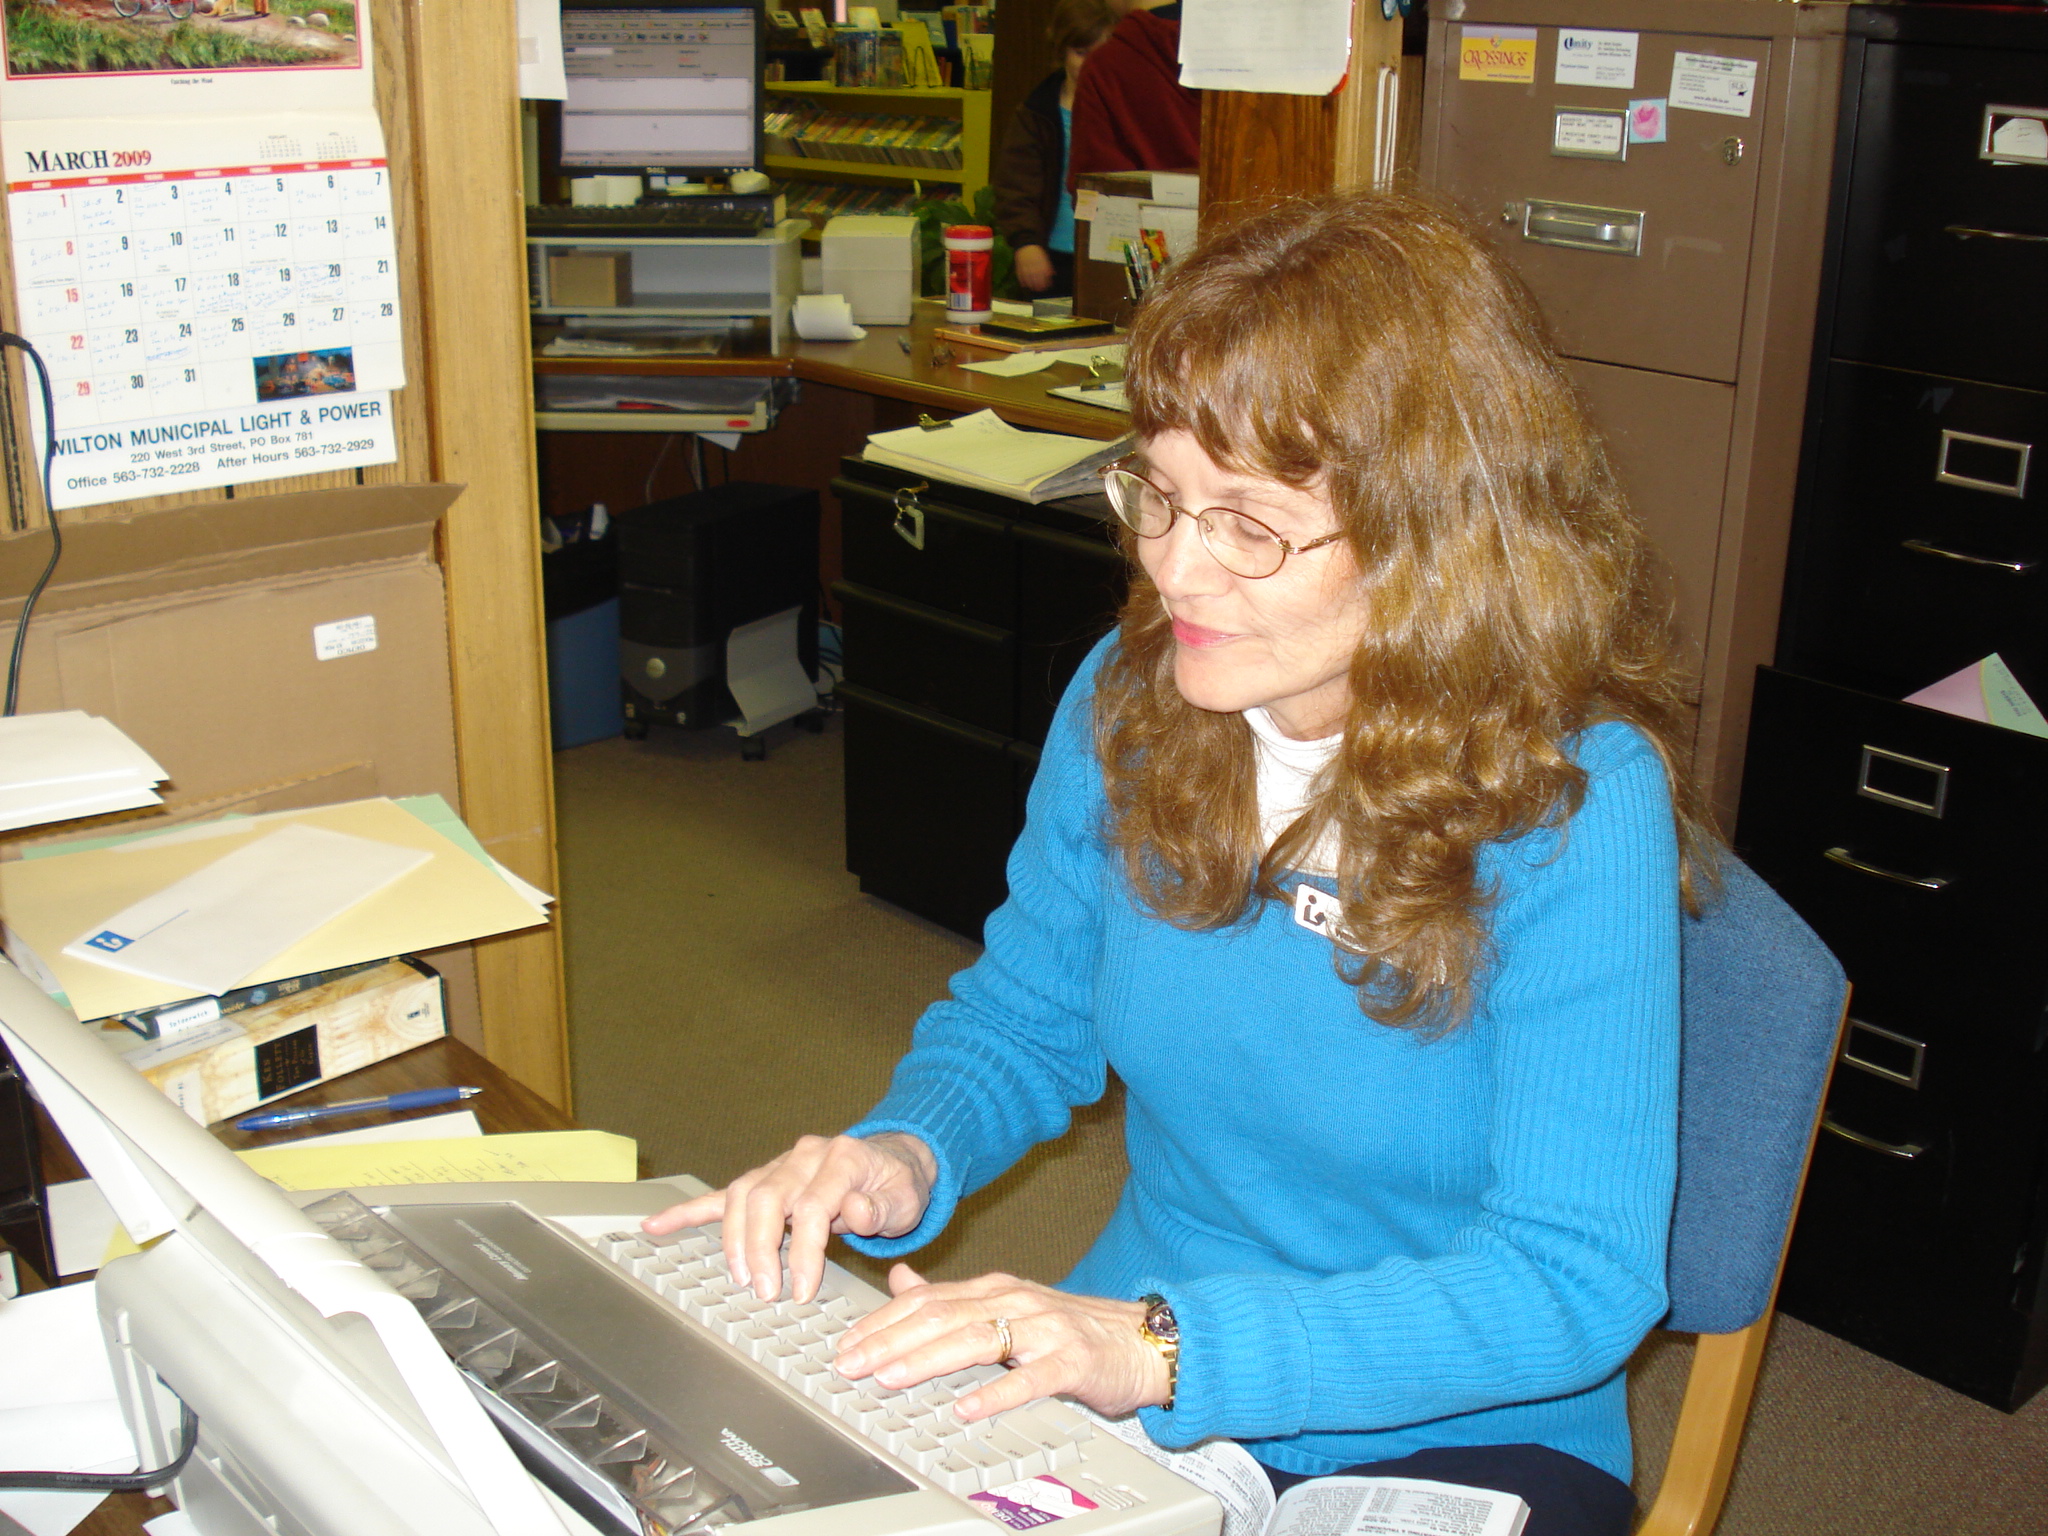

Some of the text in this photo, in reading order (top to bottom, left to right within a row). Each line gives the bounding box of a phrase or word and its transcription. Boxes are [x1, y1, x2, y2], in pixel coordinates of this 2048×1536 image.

[25, 149, 152, 174] MARCH 2009
[60, 172, 382, 208] 1 2 3 4 5 6 7
[66, 216, 386, 255] 8 9 10 11 12 13 14
[65, 260, 389, 303] 15 16 17 18 19 20 21
[70, 303, 393, 350] 22 23 24 25 26 27 28
[76, 368, 196, 396] 29 30 31
[129, 418, 234, 447] MUNICIPAL
[240, 411, 292, 433] LIGHT
[299, 409, 312, 425] &
[318, 401, 382, 423] POWER
[67, 438, 375, 490] Office 563-732-2228 After Hours 563-732-2929
[130, 431, 314, 464] 220 West 3rd Street, PO Box 781
[720, 1427, 774, 1467] CORONA
[720, 1438, 763, 1468] SMITH
